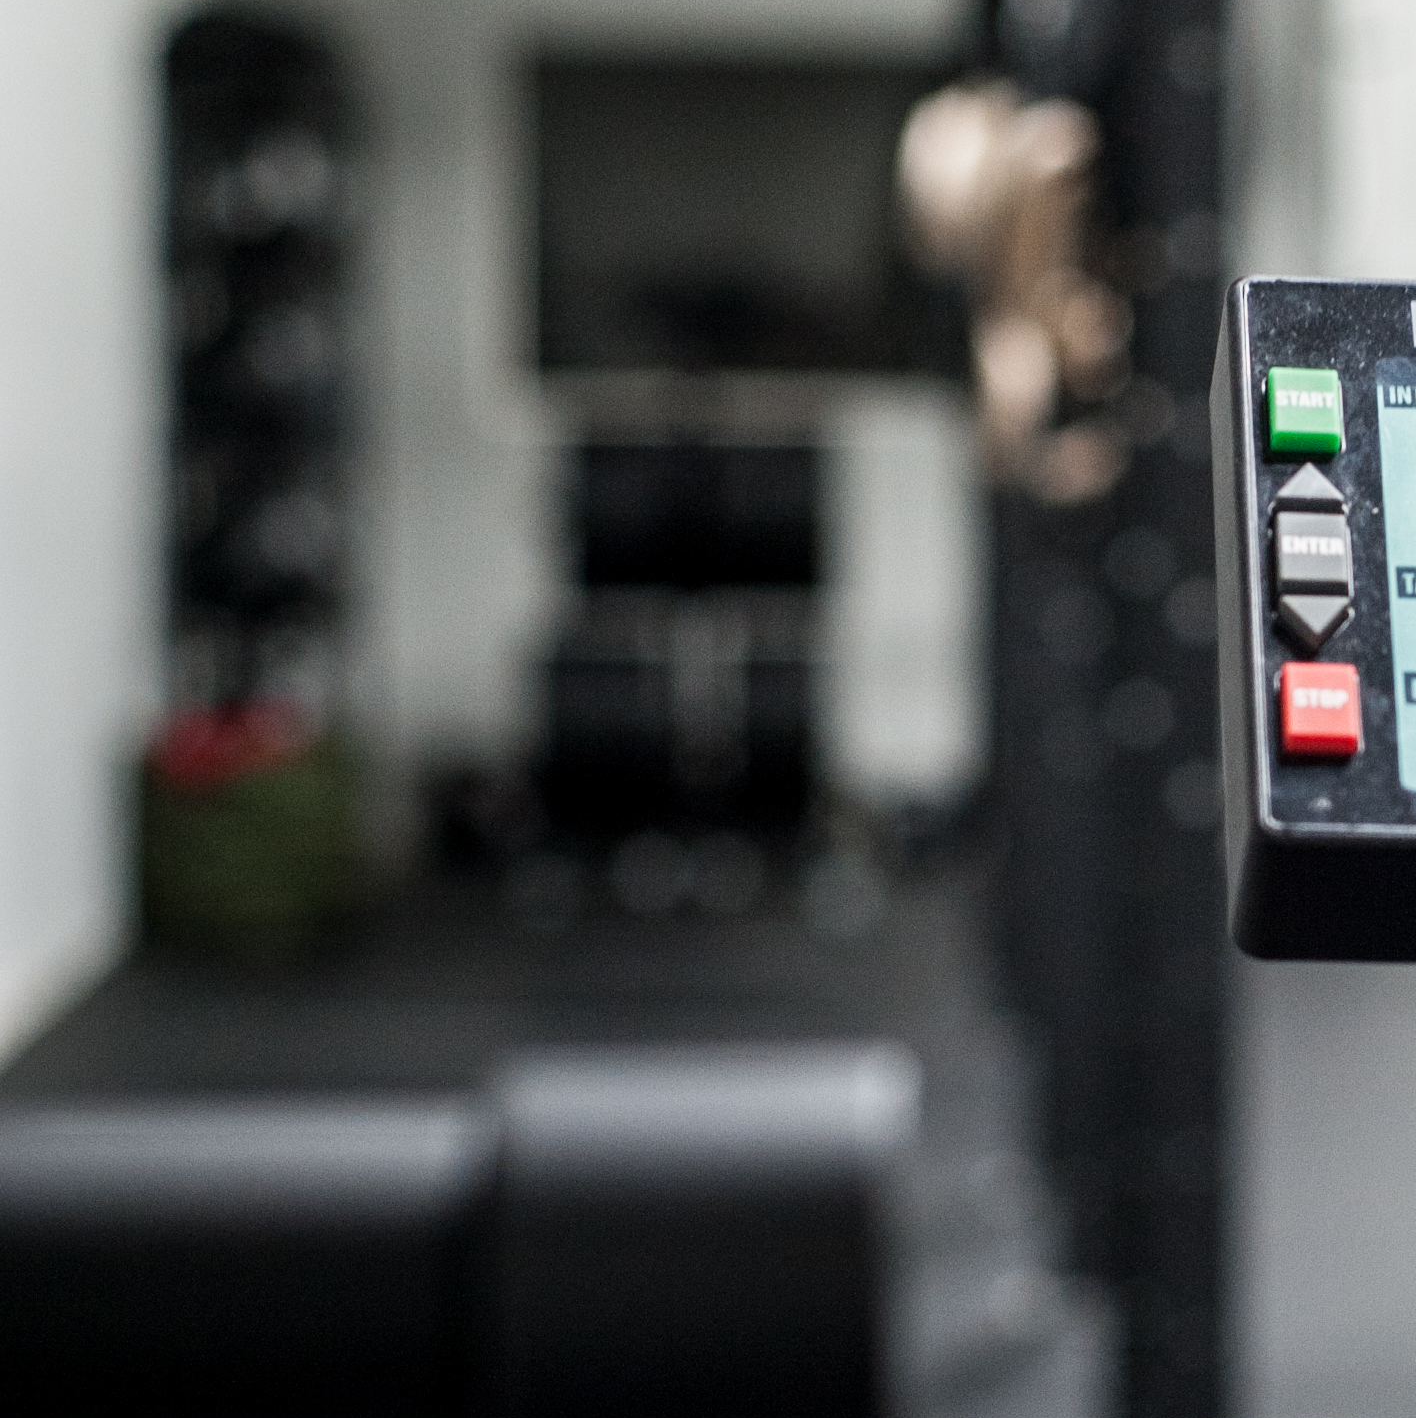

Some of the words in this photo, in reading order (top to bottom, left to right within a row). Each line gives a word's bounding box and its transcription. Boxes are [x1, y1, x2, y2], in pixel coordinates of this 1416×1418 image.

[1275, 389, 1334, 408] START
[1281, 534, 1345, 556] ENTER
[1292, 687, 1349, 710] STOP
